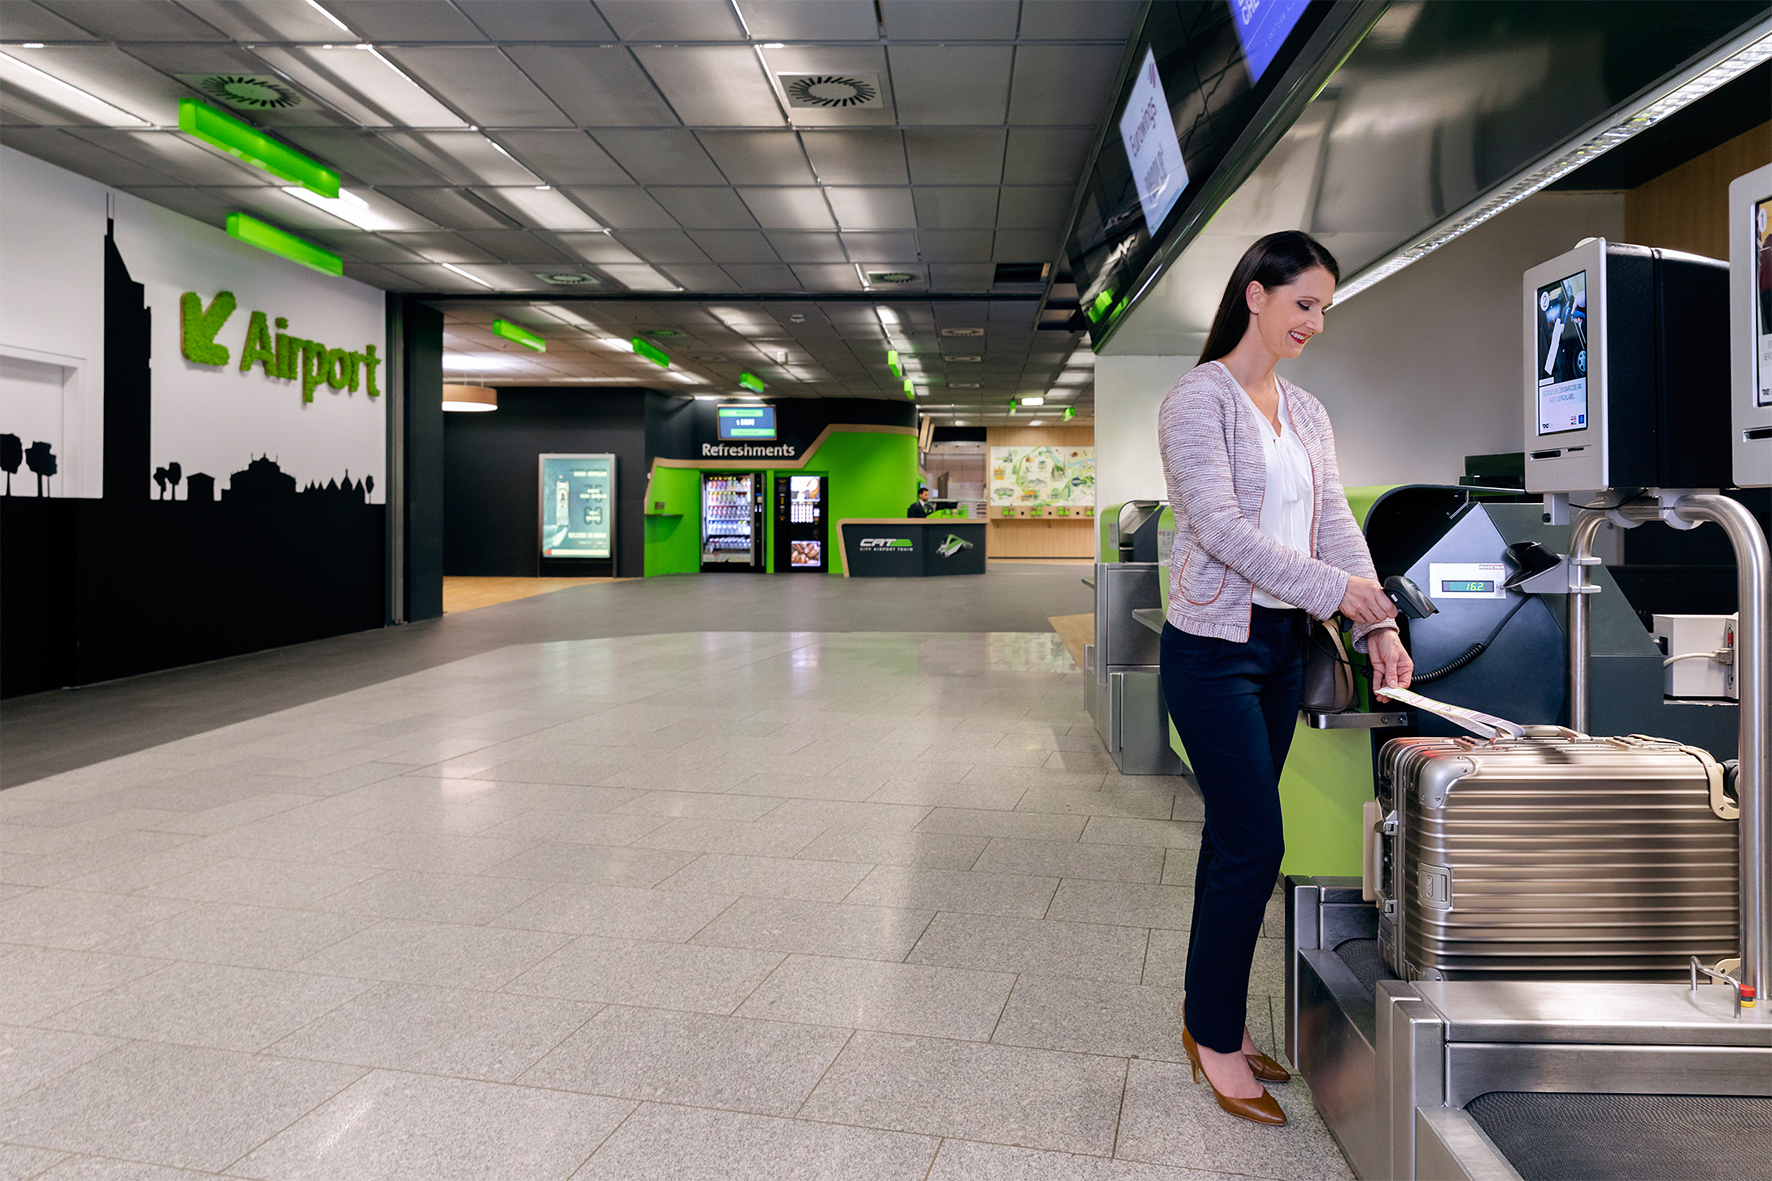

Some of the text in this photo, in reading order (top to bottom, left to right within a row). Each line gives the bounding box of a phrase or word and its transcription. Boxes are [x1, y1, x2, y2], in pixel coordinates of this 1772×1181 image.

[1129, 96, 1157, 158] Eurowings
[239, 311, 381, 403] Airport
[702, 443, 795, 457] Refreshments
[860, 538, 897, 547] CAT
[1466, 582, 1484, 591] 16.2
